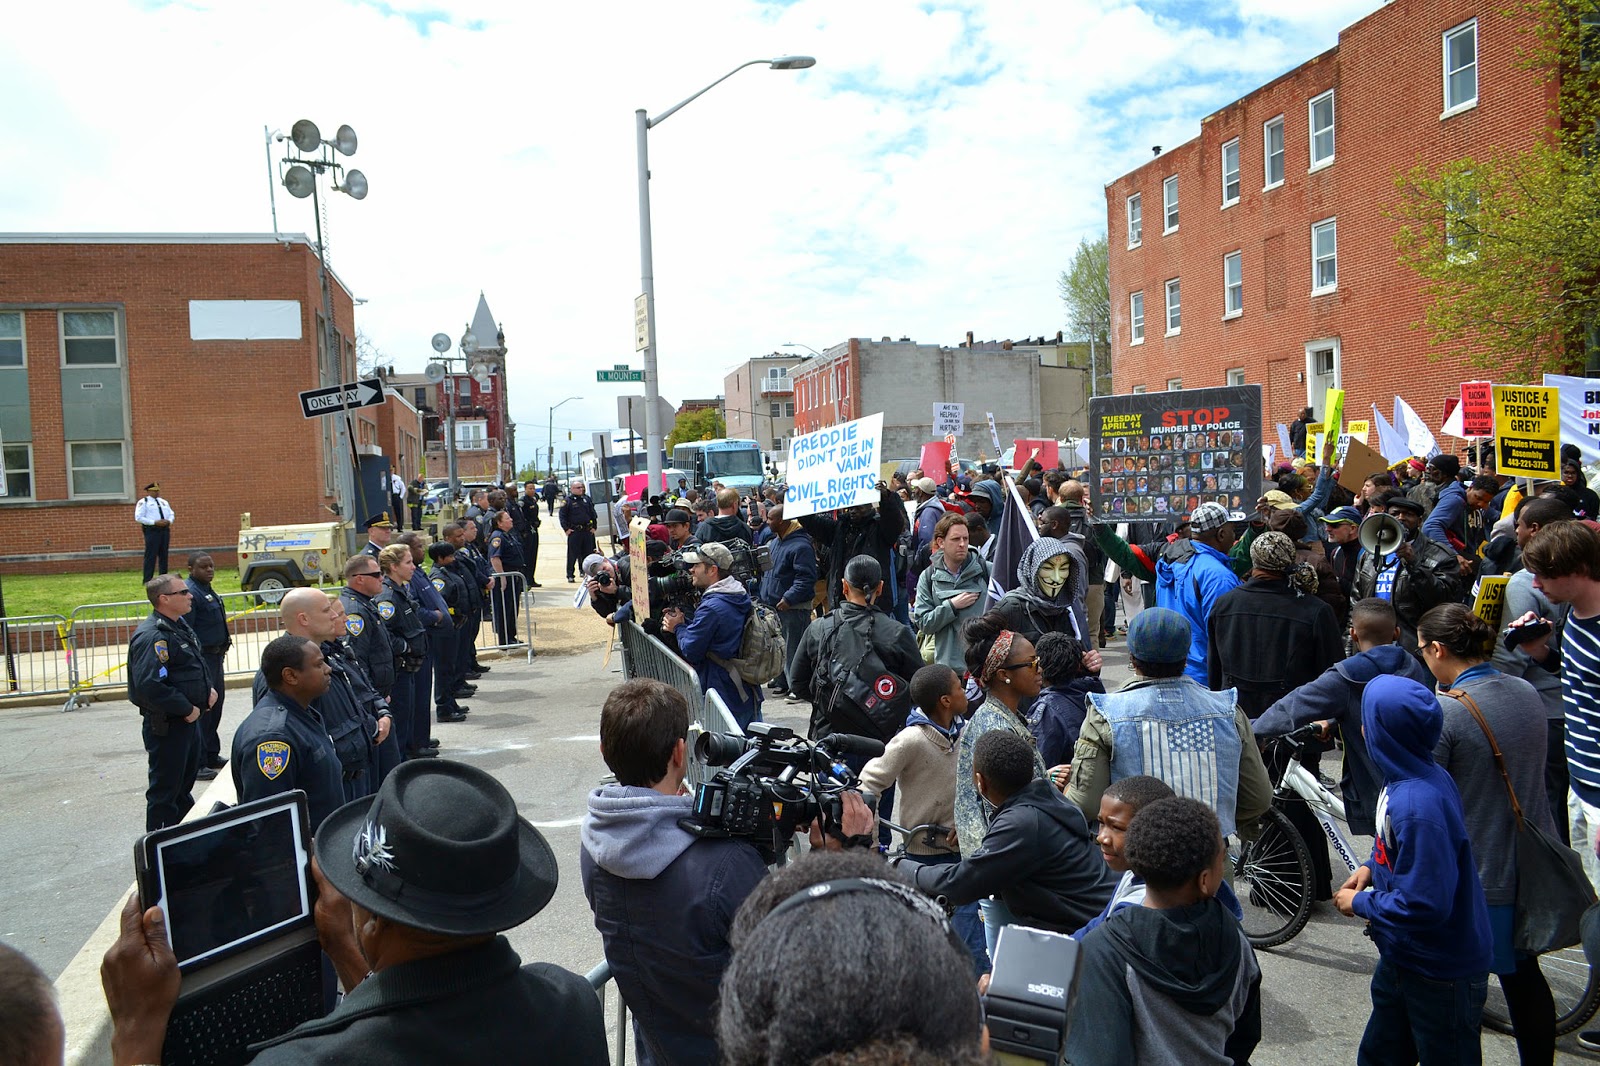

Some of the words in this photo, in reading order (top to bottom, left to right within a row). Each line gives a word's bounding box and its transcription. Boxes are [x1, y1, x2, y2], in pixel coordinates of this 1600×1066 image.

[608, 371, 632, 380] MOUNT
[1468, 391, 1486, 399] RACISM
[1501, 391, 1539, 404] JUSTICE
[1542, 392, 1549, 404] 4
[311, 396, 334, 409] ONE
[1161, 407, 1230, 428] STOP
[1504, 405, 1547, 418] FREDDIE
[1101, 414, 1142, 423] TUESDAY
[1101, 422, 1128, 430] APRIL
[1150, 425, 1189, 434] MURDER
[1206, 421, 1240, 430] POLICE
[1511, 419, 1540, 433] GREY!
[793, 423, 858, 459] FREDDIE
[1504, 439, 1529, 448] Peoples
[1529, 440, 1550, 449] Power
[797, 448, 836, 471] DIDN'T
[841, 442, 858, 458] DIE
[861, 437, 874, 452] IN
[1511, 449, 1543, 459] Assembly
[836, 451, 872, 474] VAIN!
[1507, 458, 1549, 469] 443-221-3775
[786, 481, 823, 503] CIVIL
[827, 472, 876, 494] RIGHTS
[811, 490, 857, 512] TODAY!
[1322, 821, 1356, 872] mongoose
